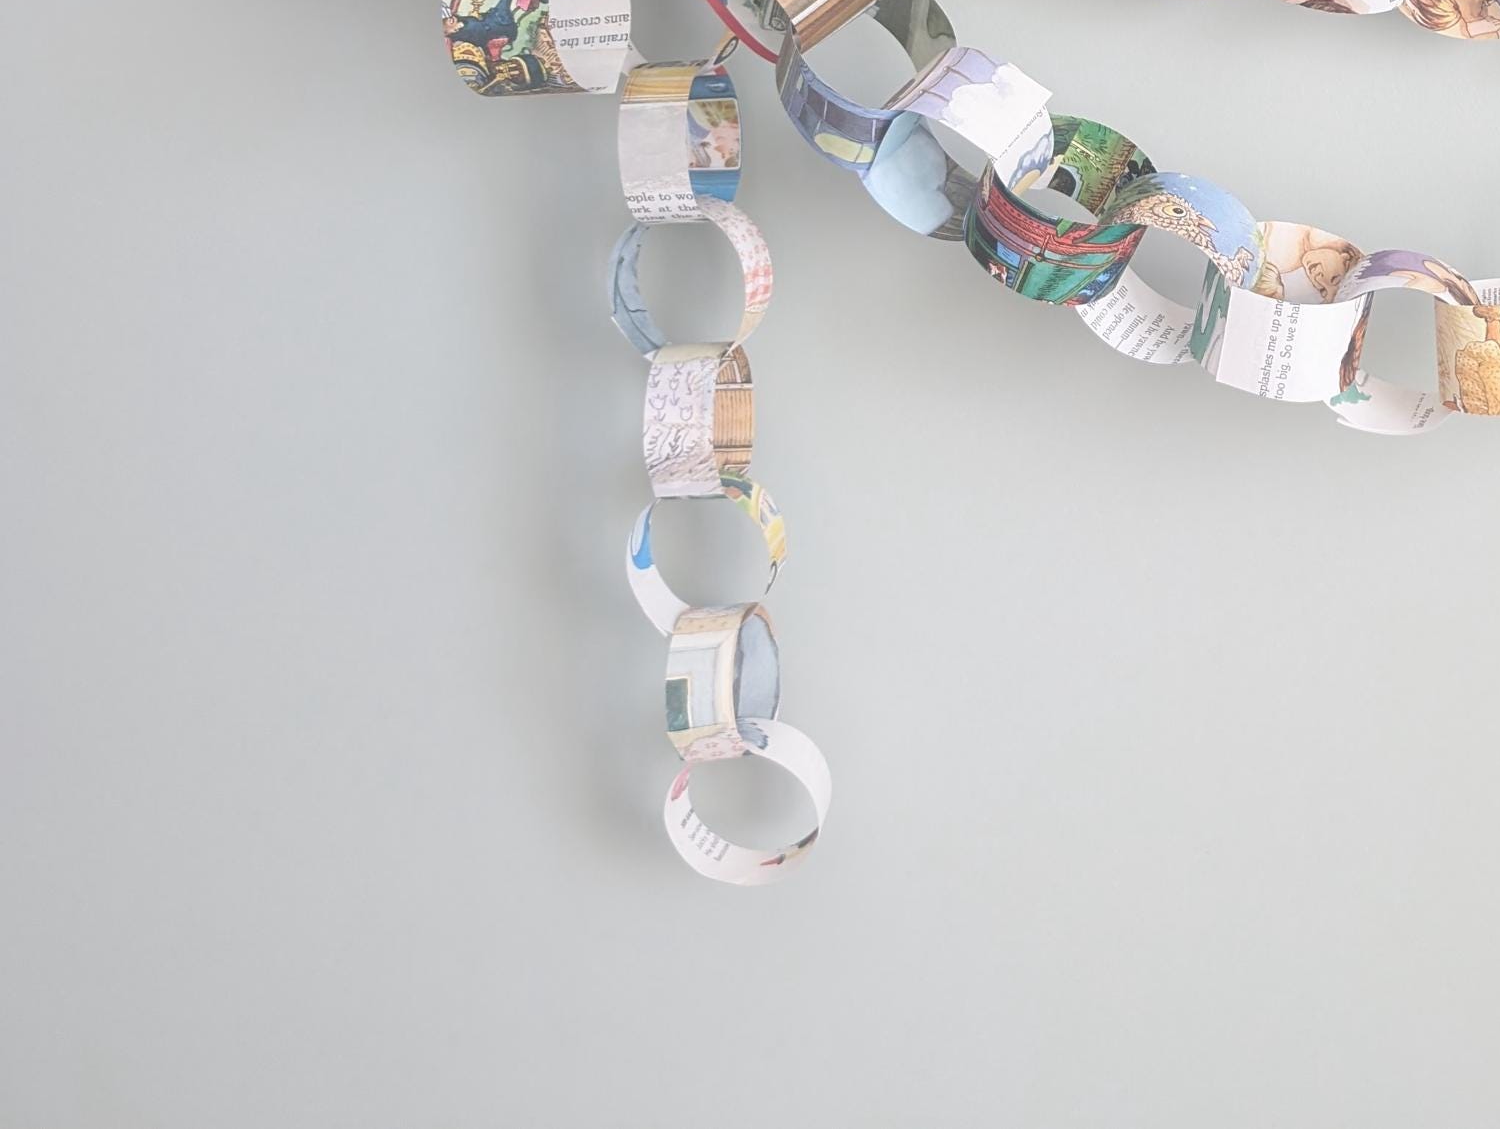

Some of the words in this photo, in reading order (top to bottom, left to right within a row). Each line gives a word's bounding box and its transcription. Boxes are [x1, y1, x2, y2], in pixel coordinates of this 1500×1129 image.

[549, 16, 601, 32] crossing
[560, 37, 580, 49] the
[583, 36, 596, 47] in
[659, 193, 672, 201] to
[1271, 318, 1283, 333] up
[1286, 326, 1297, 342] we
[1268, 334, 1277, 352] me
[1280, 344, 1293, 359] So
[1258, 353, 1274, 398] splashes
[1276, 362, 1292, 380] big.
[1274, 382, 1286, 399] too
